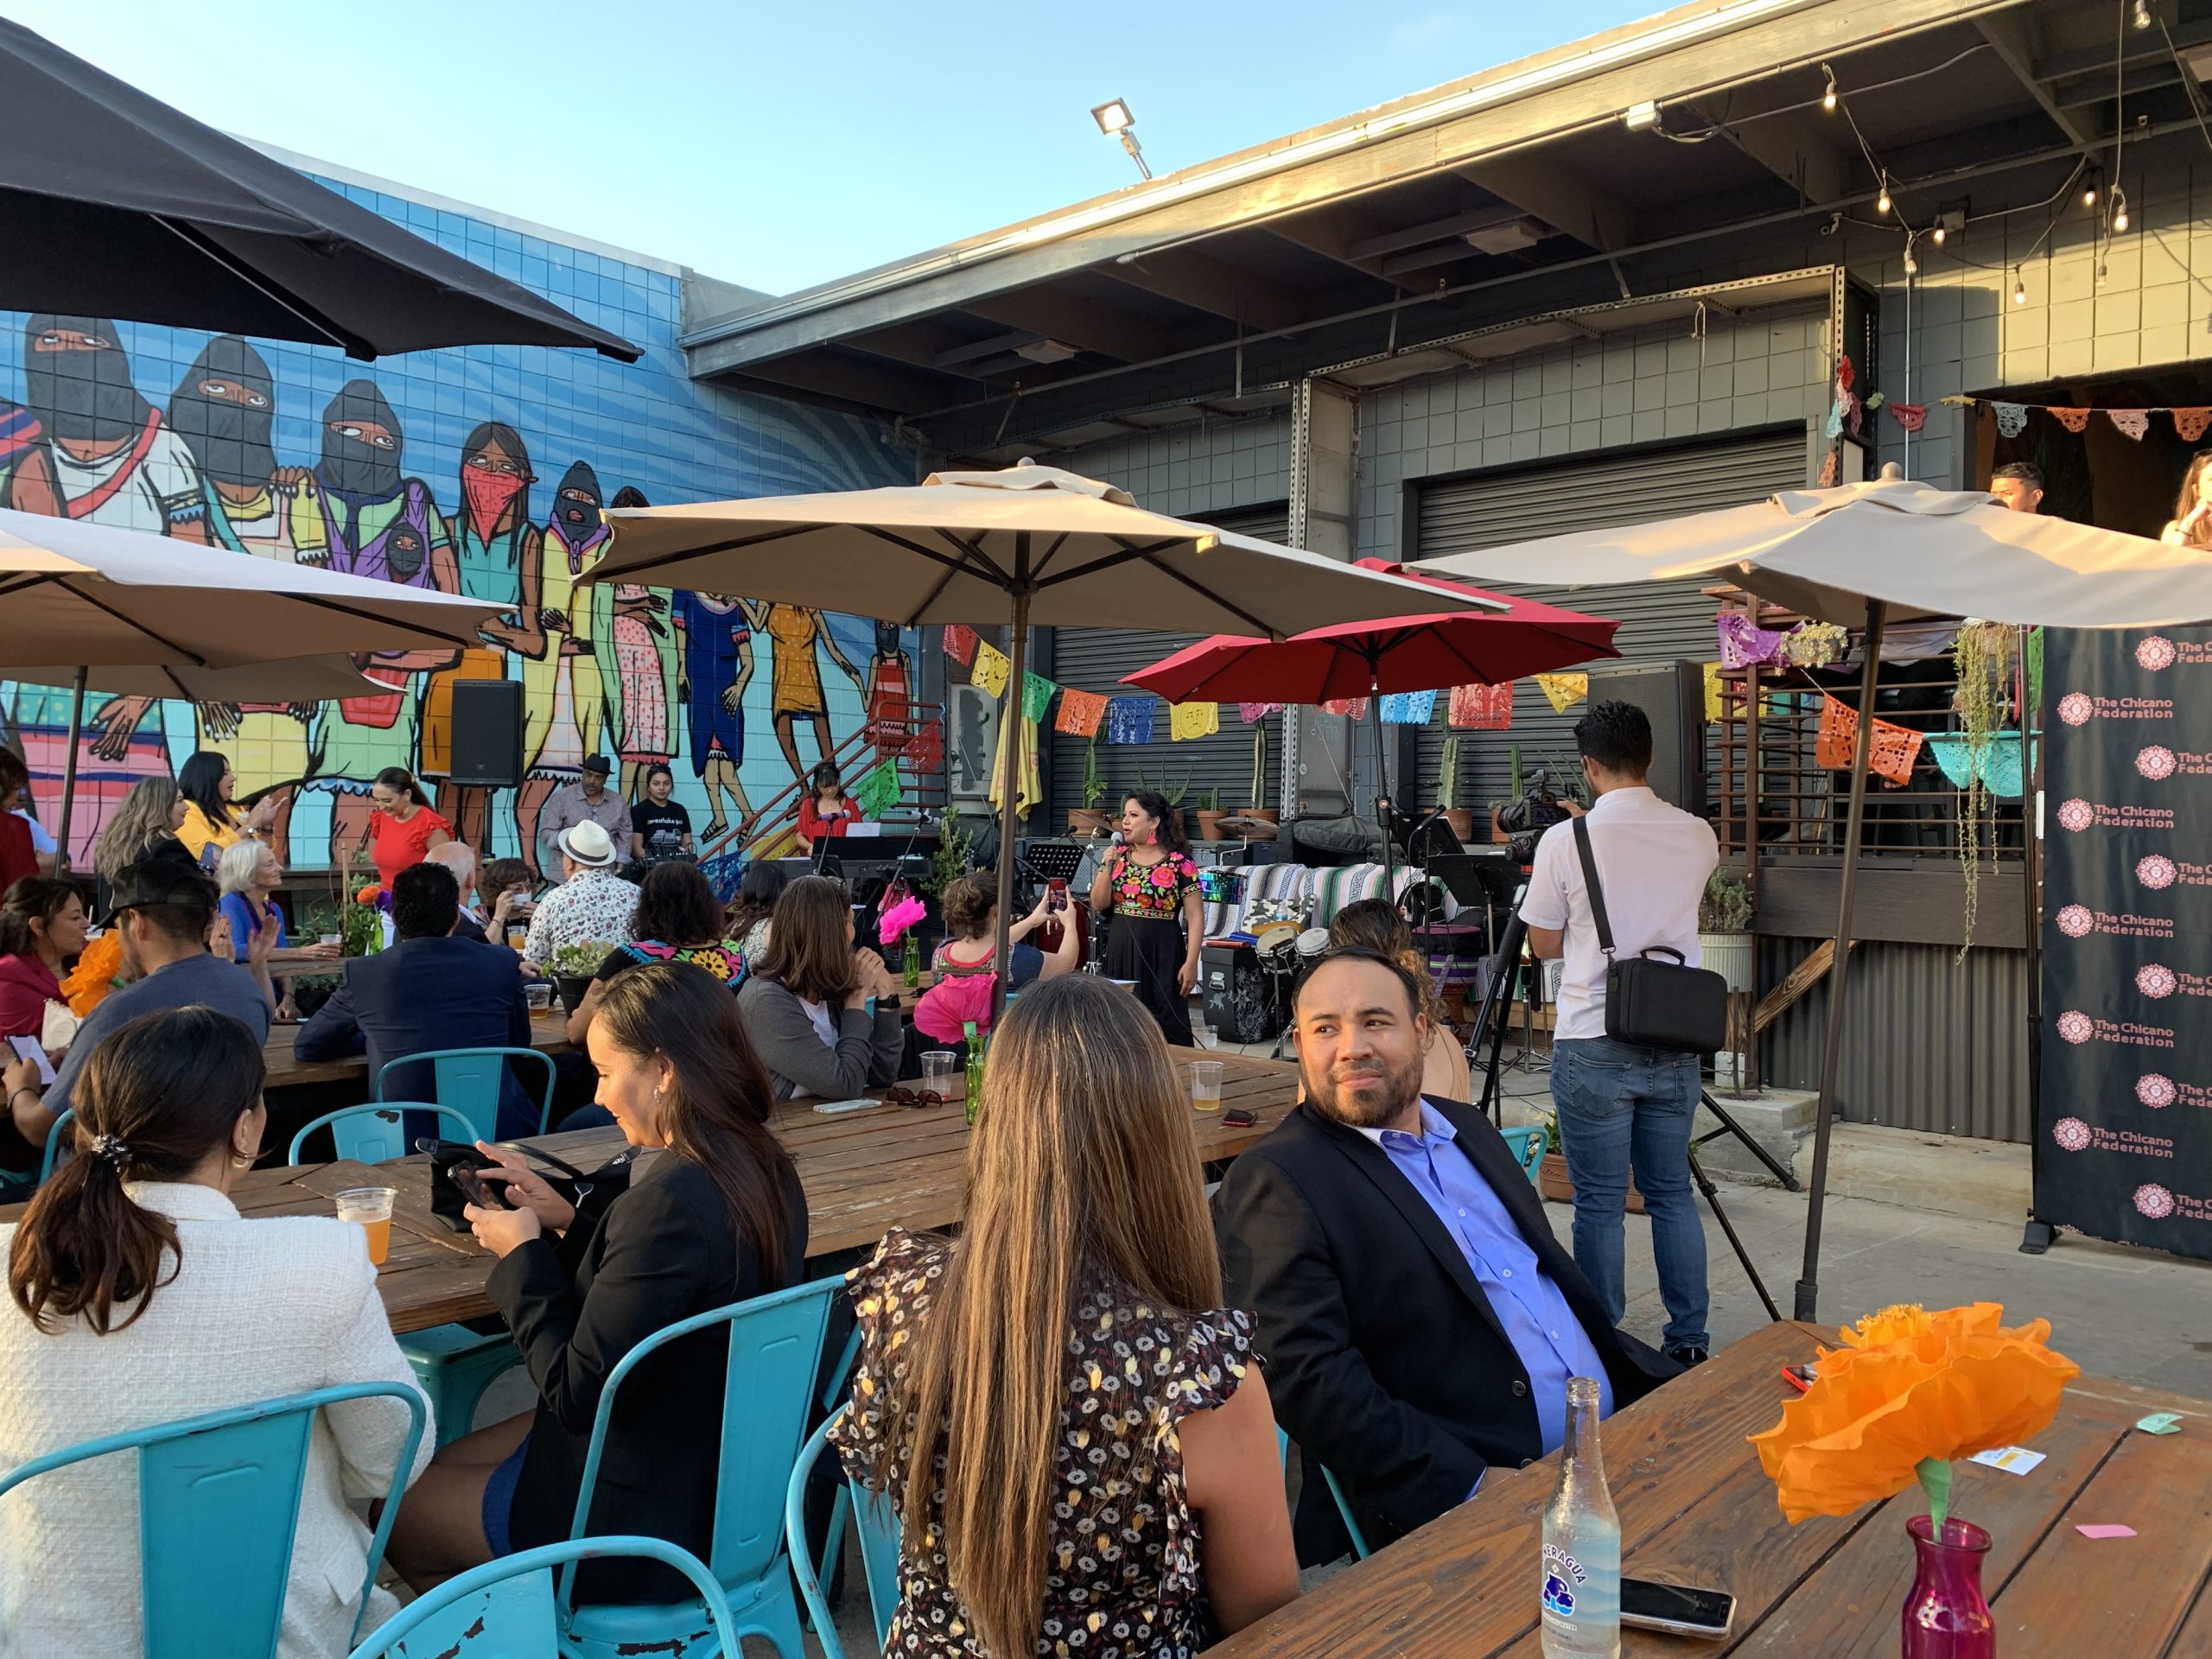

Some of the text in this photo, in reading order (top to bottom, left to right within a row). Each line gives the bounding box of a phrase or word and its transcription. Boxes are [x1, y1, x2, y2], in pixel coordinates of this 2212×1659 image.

[2177, 641, 2202, 652] The
[2094, 696, 2173, 708] The Chicano
[2094, 708, 2173, 718] Federation
[2177, 753, 2202, 763] The
[2094, 804, 2174, 817] The Chicano
[2094, 815, 2174, 828] Federation
[2178, 863, 2203, 874] The
[2094, 912, 2174, 927] The Chicano
[2094, 922, 2174, 938] Federation
[2178, 973, 2203, 985] The
[2094, 1020, 2174, 1037] The Chicano
[2094, 1030, 2174, 1048] Federation
[2178, 1084, 2203, 1096] The
[2093, 1127, 2173, 1147] The Chicano
[2093, 1138, 2173, 1158] Federation
[2177, 1194, 2202, 1208] The
